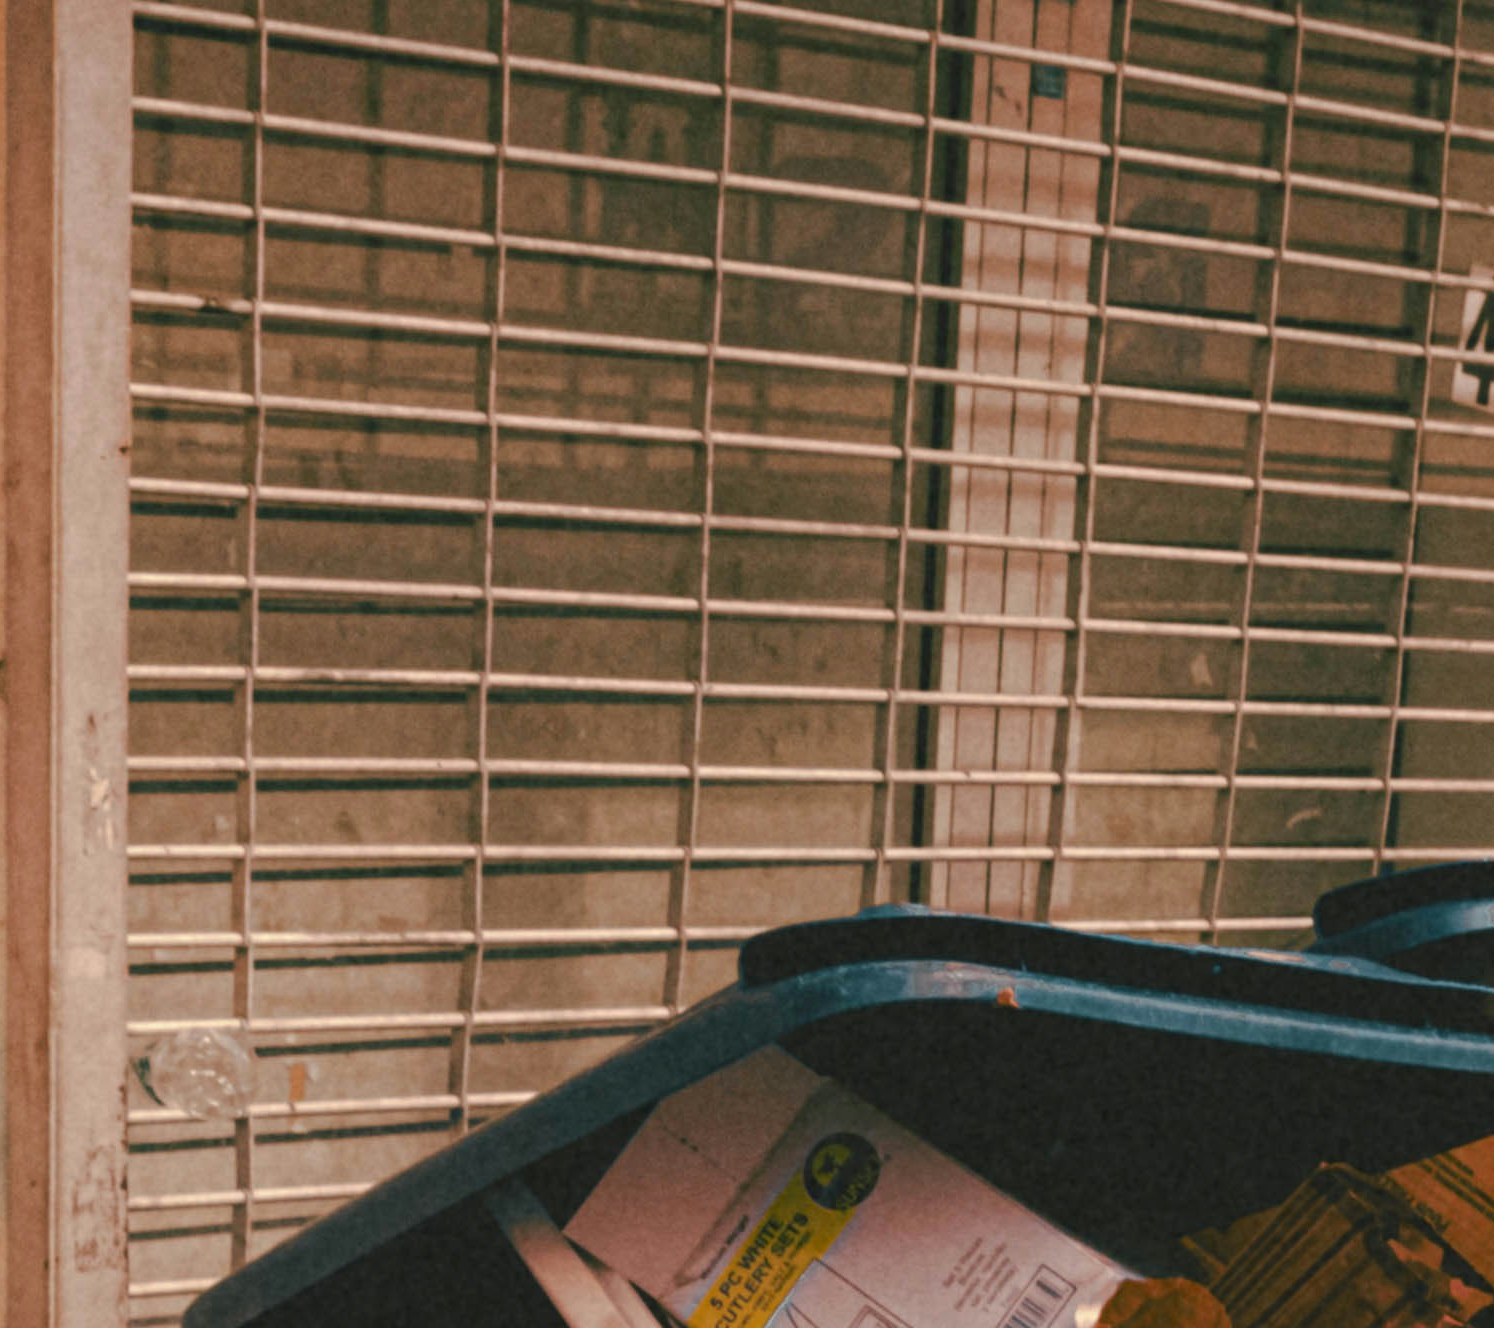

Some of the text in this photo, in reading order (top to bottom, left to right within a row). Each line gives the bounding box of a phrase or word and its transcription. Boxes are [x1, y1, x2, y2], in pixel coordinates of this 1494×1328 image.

[710, 1217, 785, 1311] 5 PC WHITE
[771, 1211, 809, 1258] SETS
